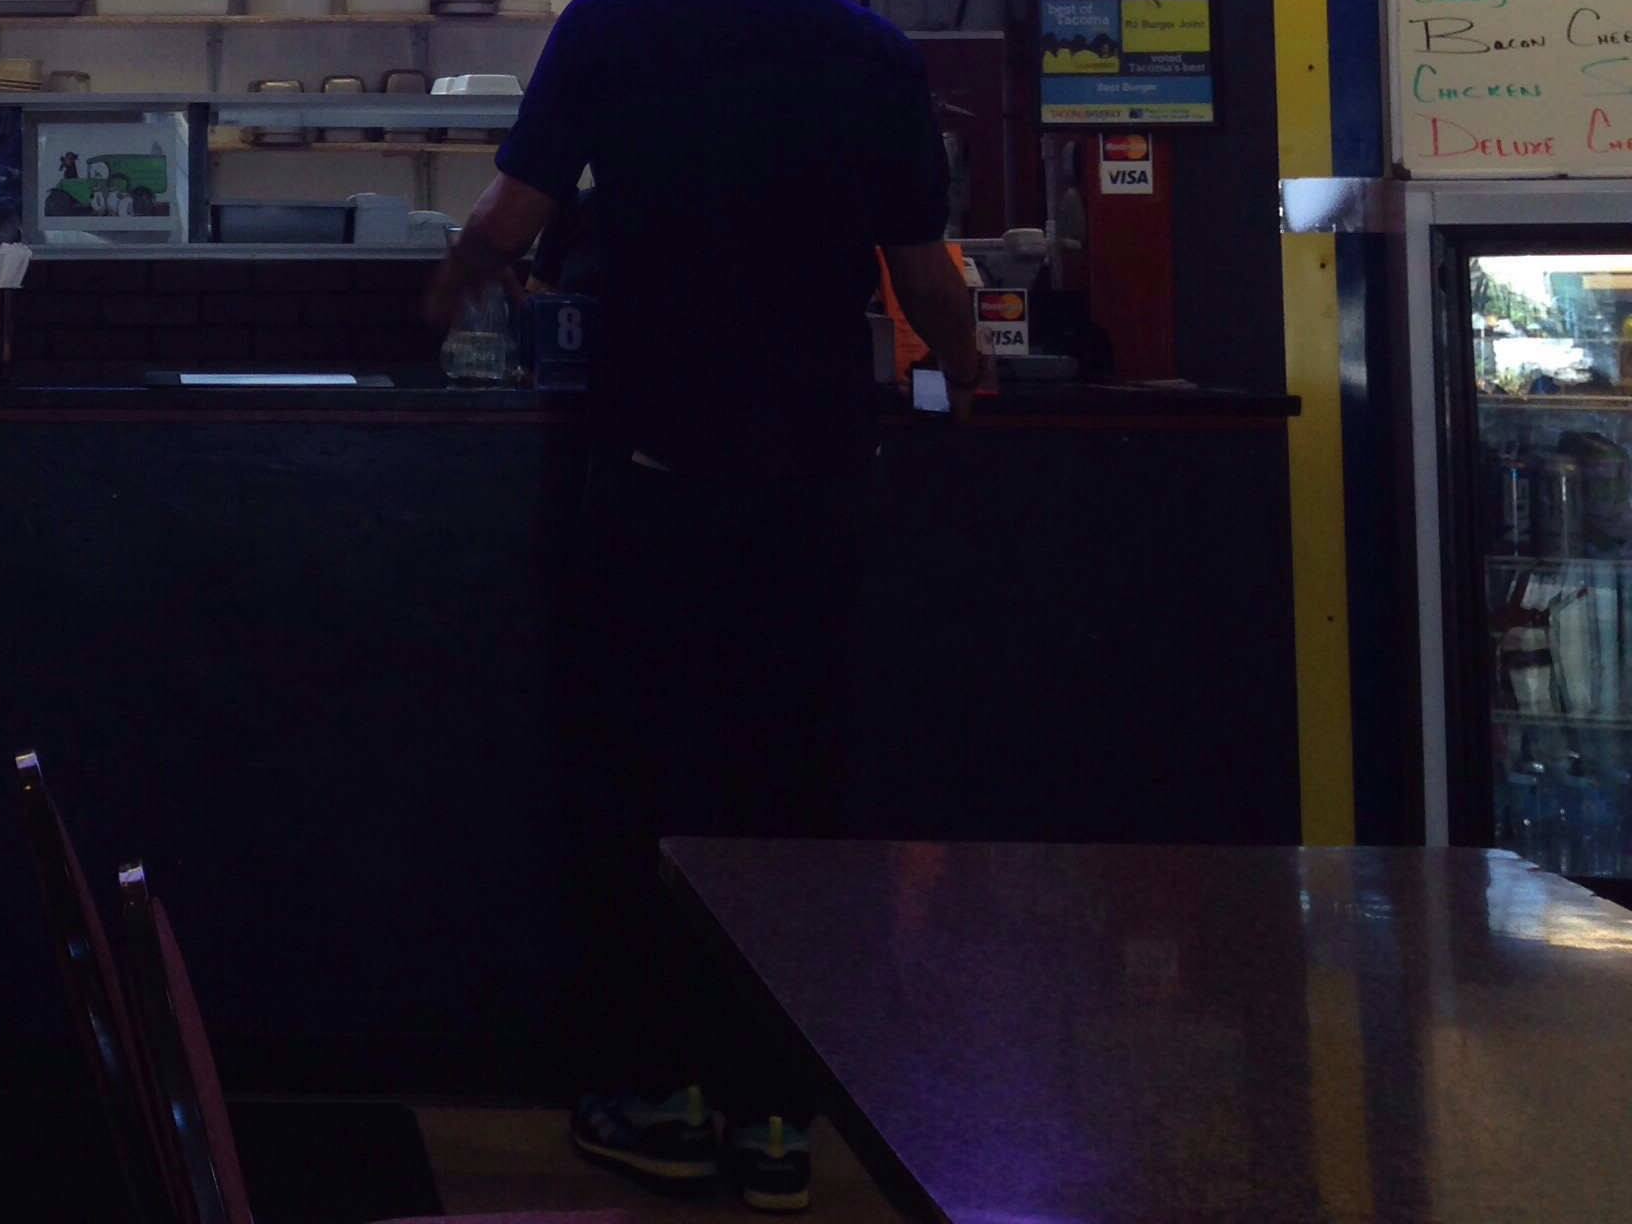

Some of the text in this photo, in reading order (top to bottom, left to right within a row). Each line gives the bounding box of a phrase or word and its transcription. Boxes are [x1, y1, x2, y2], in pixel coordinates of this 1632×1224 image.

[1057, 14, 1111, 26] Tacoma
[1151, 55, 1183, 64] voted
[1109, 170, 1149, 185] VISA
